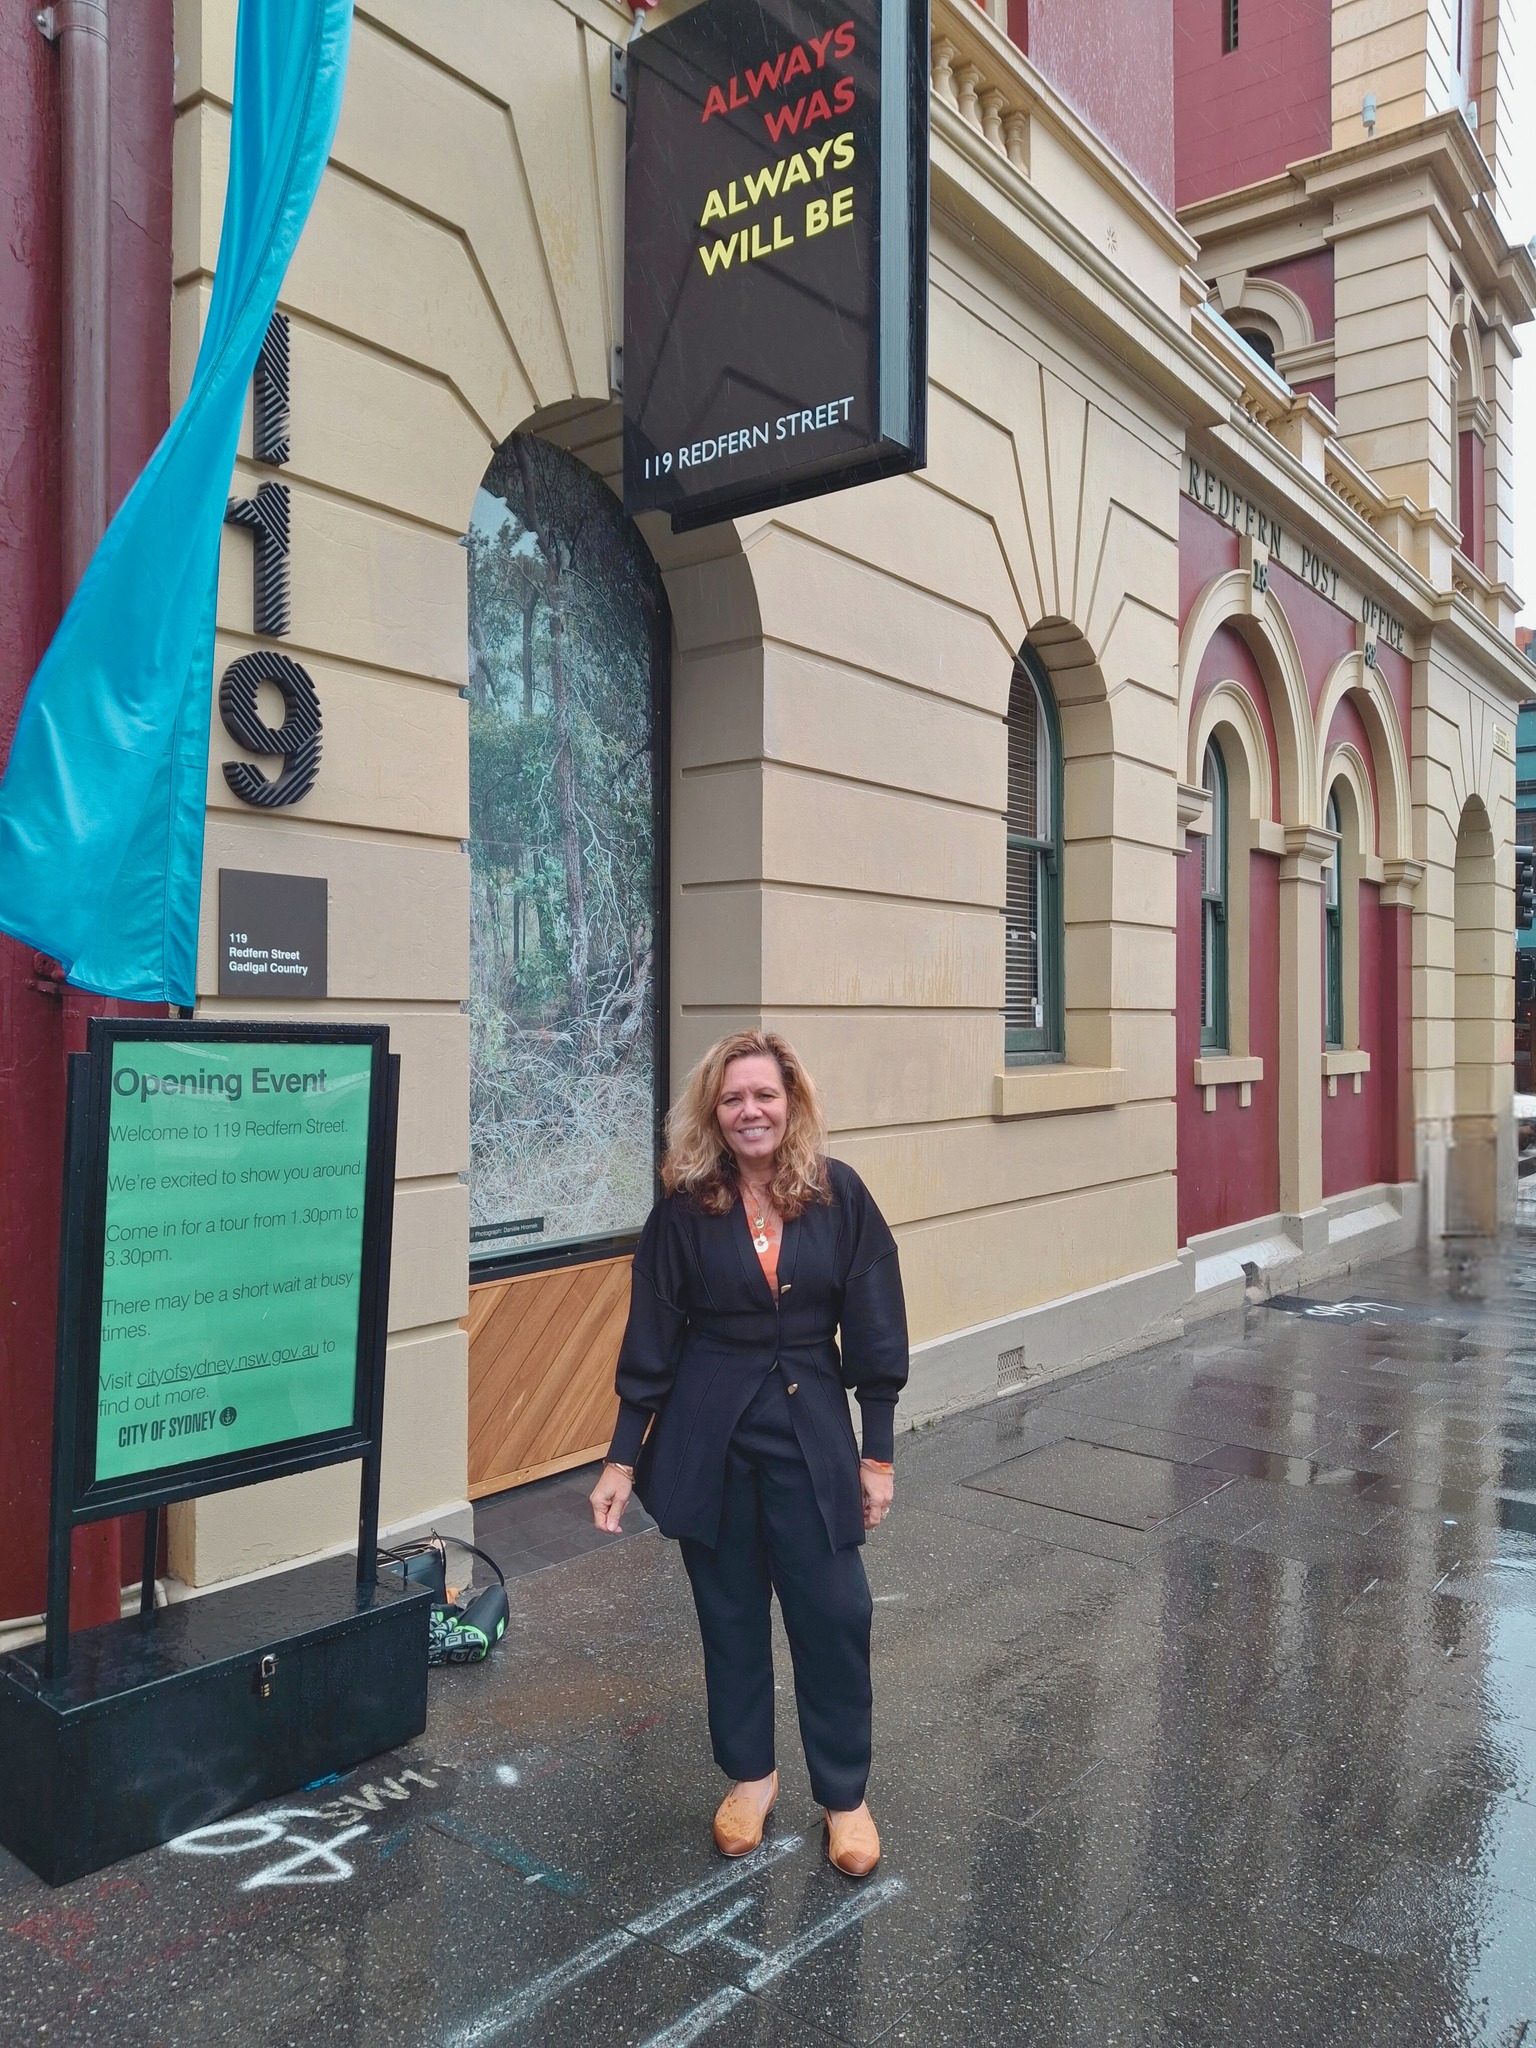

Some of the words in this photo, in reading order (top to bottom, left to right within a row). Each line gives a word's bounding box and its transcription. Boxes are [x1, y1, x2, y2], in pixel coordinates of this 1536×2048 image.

[701, 21, 856, 123] ALWAYS
[764, 76, 856, 143] WAS
[700, 132, 856, 227] ALWAYS
[699, 215, 794, 276] WILL
[806, 187, 854, 238] BE
[644, 452, 673, 479] 119
[679, 421, 769, 468] REDFERN
[776, 396, 855, 441] STREET
[1189, 457, 1281, 559] REDFERN
[1302, 545, 1339, 601] POST
[1362, 596, 1405, 652] OFFICE
[1252, 558, 1269, 593] 18
[229, 933, 248, 943] 119
[229, 947, 269, 958] Redfern
[271, 949, 300, 960] Street
[229, 961, 267, 974] Gadigal
[270, 963, 308, 976] Country
[113, 1068, 242, 1103] Opening
[252, 1068, 327, 1094] Event
[110, 1125, 188, 1142] Welcome
[193, 1124, 208, 1139] to
[213, 1122, 241, 1138] 119
[246, 1120, 301, 1136] Redfern
[306, 1118, 348, 1134] Street.
[109, 1174, 156, 1192] We're
[161, 1169, 217, 1188] excited
[222, 1169, 236, 1184] to
[240, 1167, 282, 1183] show
[283, 1166, 309, 1184] you
[313, 1160, 364, 1179] around.
[106, 1224, 158, 1242] Come
[163, 1221, 176, 1237] in
[181, 1219, 202, 1235] for
[205, 1220, 216, 1233] a
[219, 1216, 250, 1232] tour
[253, 1212, 286, 1228] from
[290, 1207, 342, 1226] 1.30pm
[345, 1205, 358, 1219] to
[104, 1247, 172, 1268] 3.30pm.
[102, 1297, 150, 1317] There
[155, 1293, 190, 1311] may
[194, 1289, 214, 1306] be
[218, 1288, 228, 1301] a
[232, 1281, 269, 1300] short
[273, 1276, 301, 1294] wait
[304, 1274, 317, 1290] at
[320, 1271, 353, 1288] busy
[101, 1323, 150, 1342] times.
[99, 1373, 133, 1391] Visit
[136, 1343, 319, 1389] cityofsydney.nsw.gov.au
[322, 1340, 336, 1354] to
[98, 1400, 129, 1416] find
[134, 1393, 160, 1410] out
[164, 1386, 209, 1405] more.
[118, 1422, 147, 1447] CITY
[151, 1420, 166, 1441] OF
[169, 1410, 217, 1438] SYDNEY
